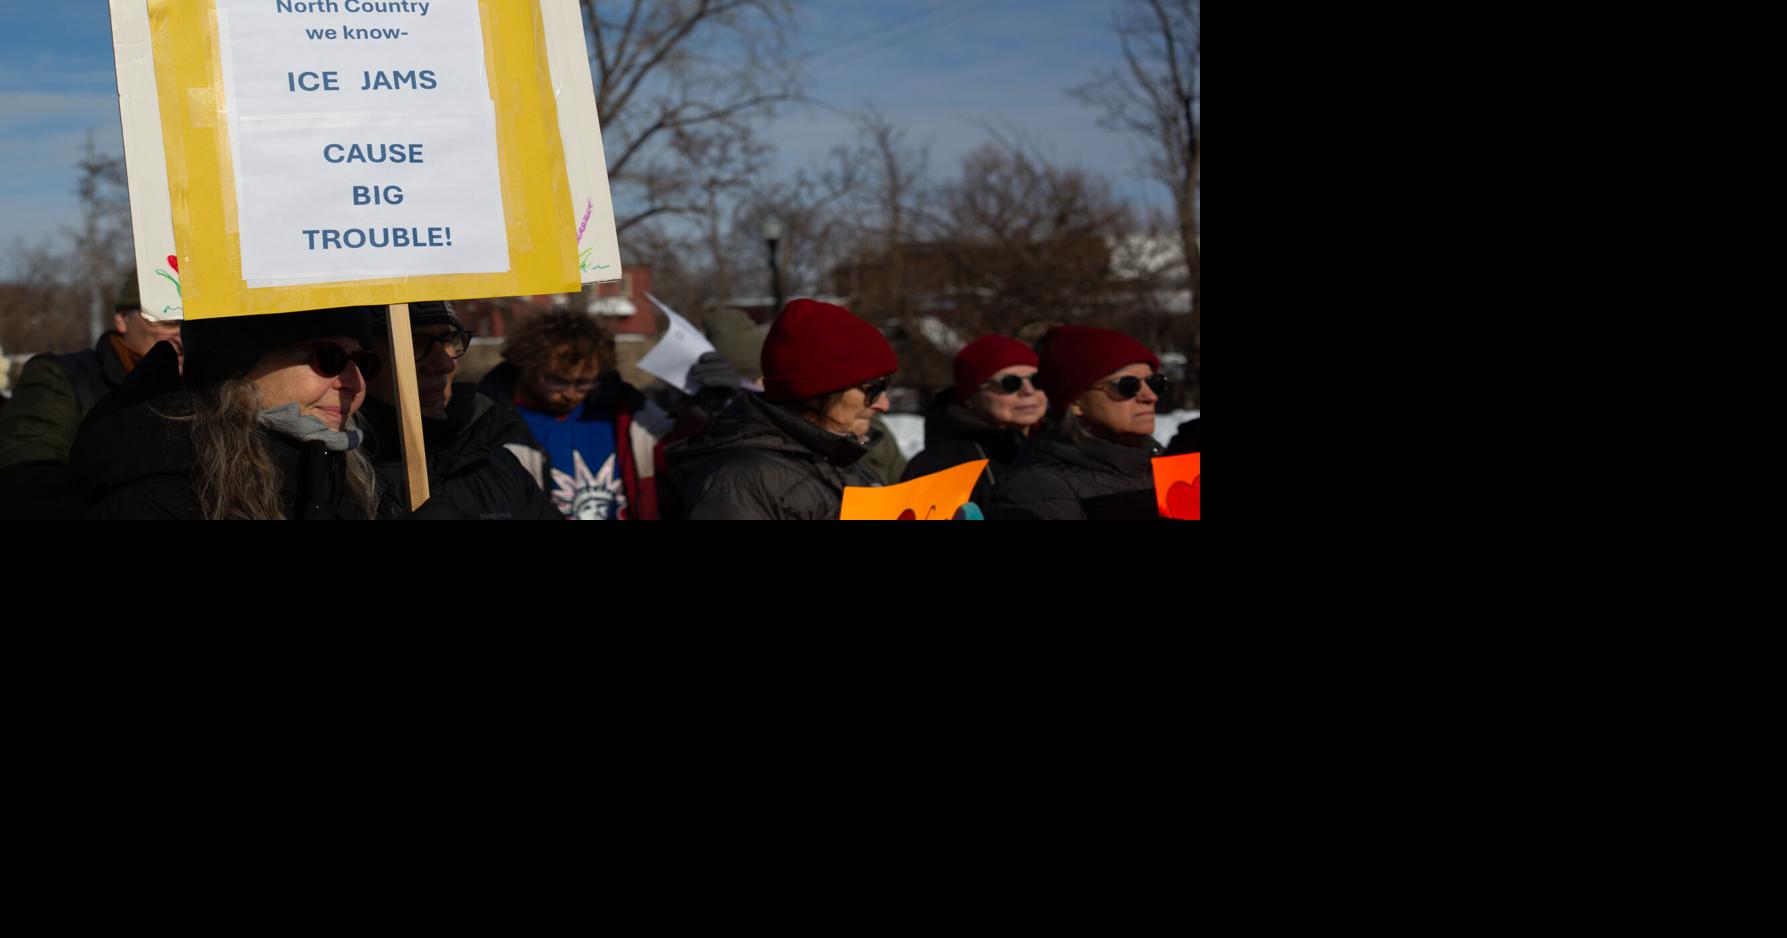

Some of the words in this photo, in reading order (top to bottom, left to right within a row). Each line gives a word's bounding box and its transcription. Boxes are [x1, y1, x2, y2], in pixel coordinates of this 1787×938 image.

[276, 0, 339, 13] North
[344, 0, 430, 17] Country
[305, 28, 337, 40] we
[342, 25, 410, 40] know-
[287, 71, 340, 92] ICE
[360, 69, 438, 91] JAMS
[323, 143, 424, 164] CAUSE
[352, 185, 404, 206] BIG
[302, 226, 453, 250] TROUBLE!
